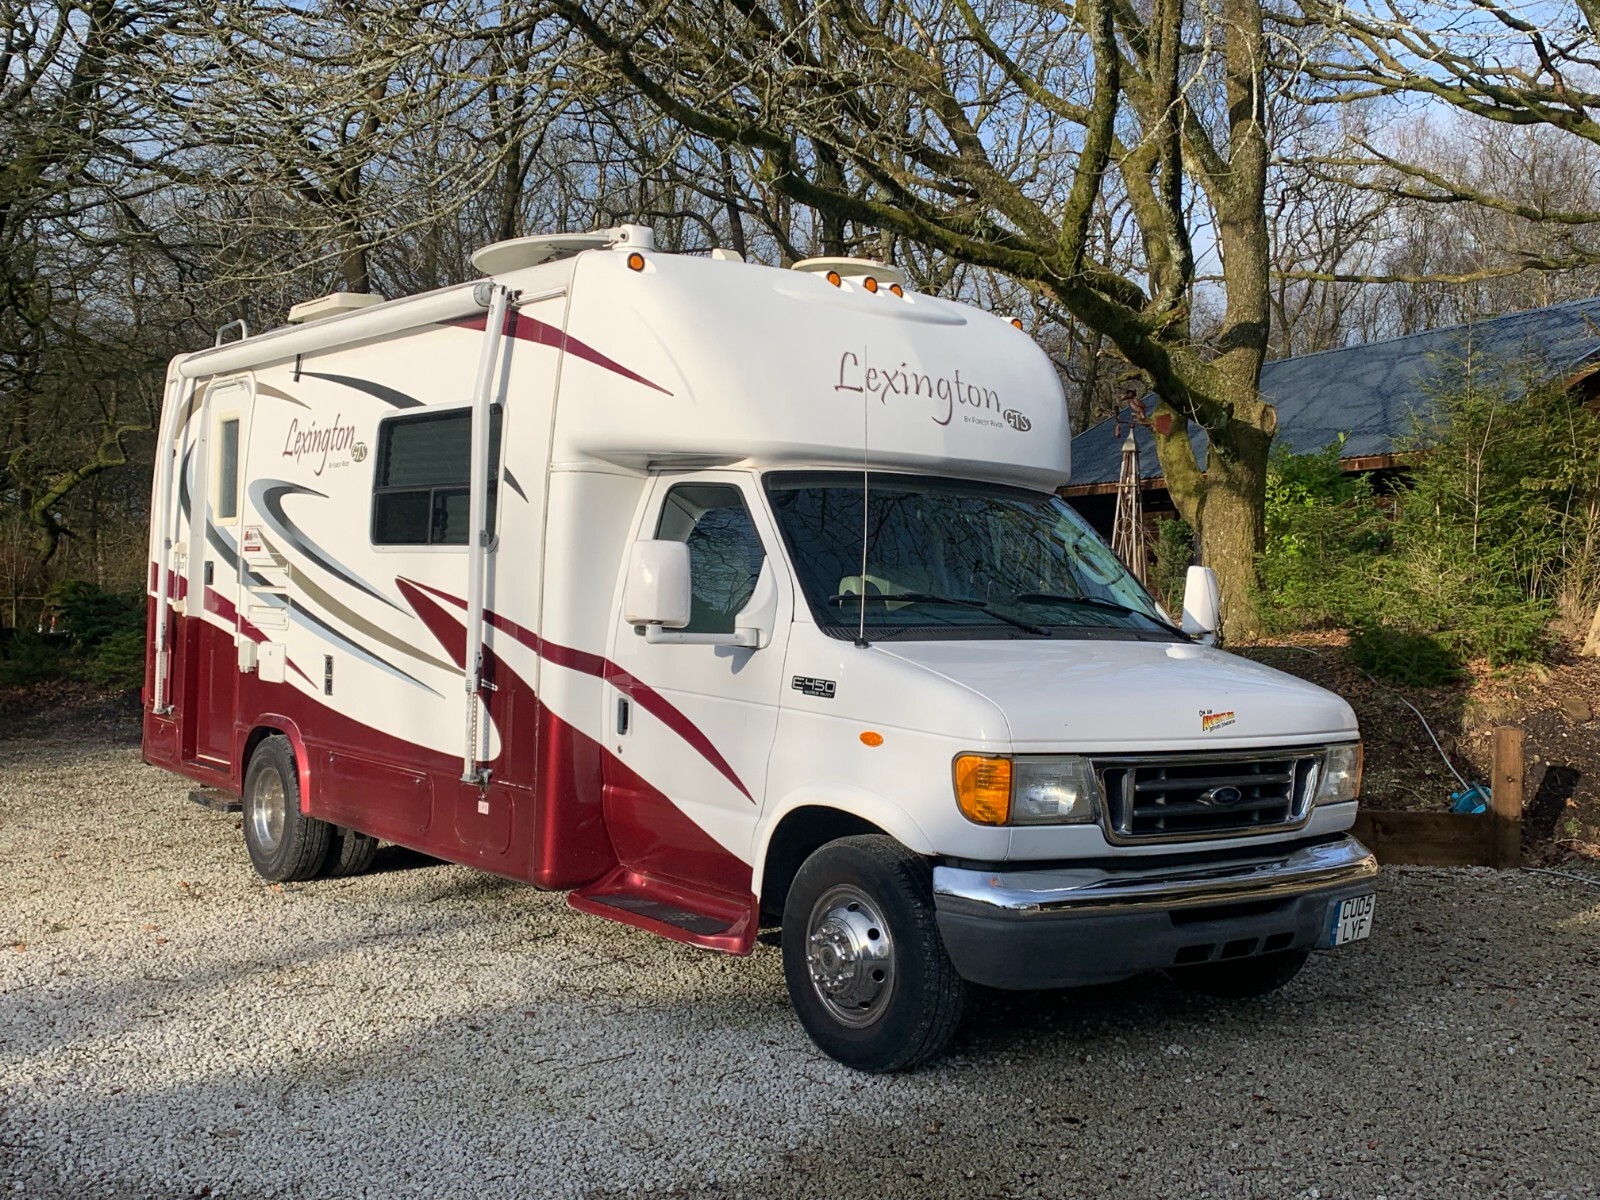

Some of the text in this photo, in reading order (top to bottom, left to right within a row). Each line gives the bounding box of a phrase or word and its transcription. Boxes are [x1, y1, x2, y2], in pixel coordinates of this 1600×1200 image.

[834, 351, 1001, 426] Lexington
[1004, 409, 1030, 431] GTS
[282, 412, 355, 476] Lexington
[1342, 895, 1373, 920] CU05
[1342, 918, 1366, 942] LYF
